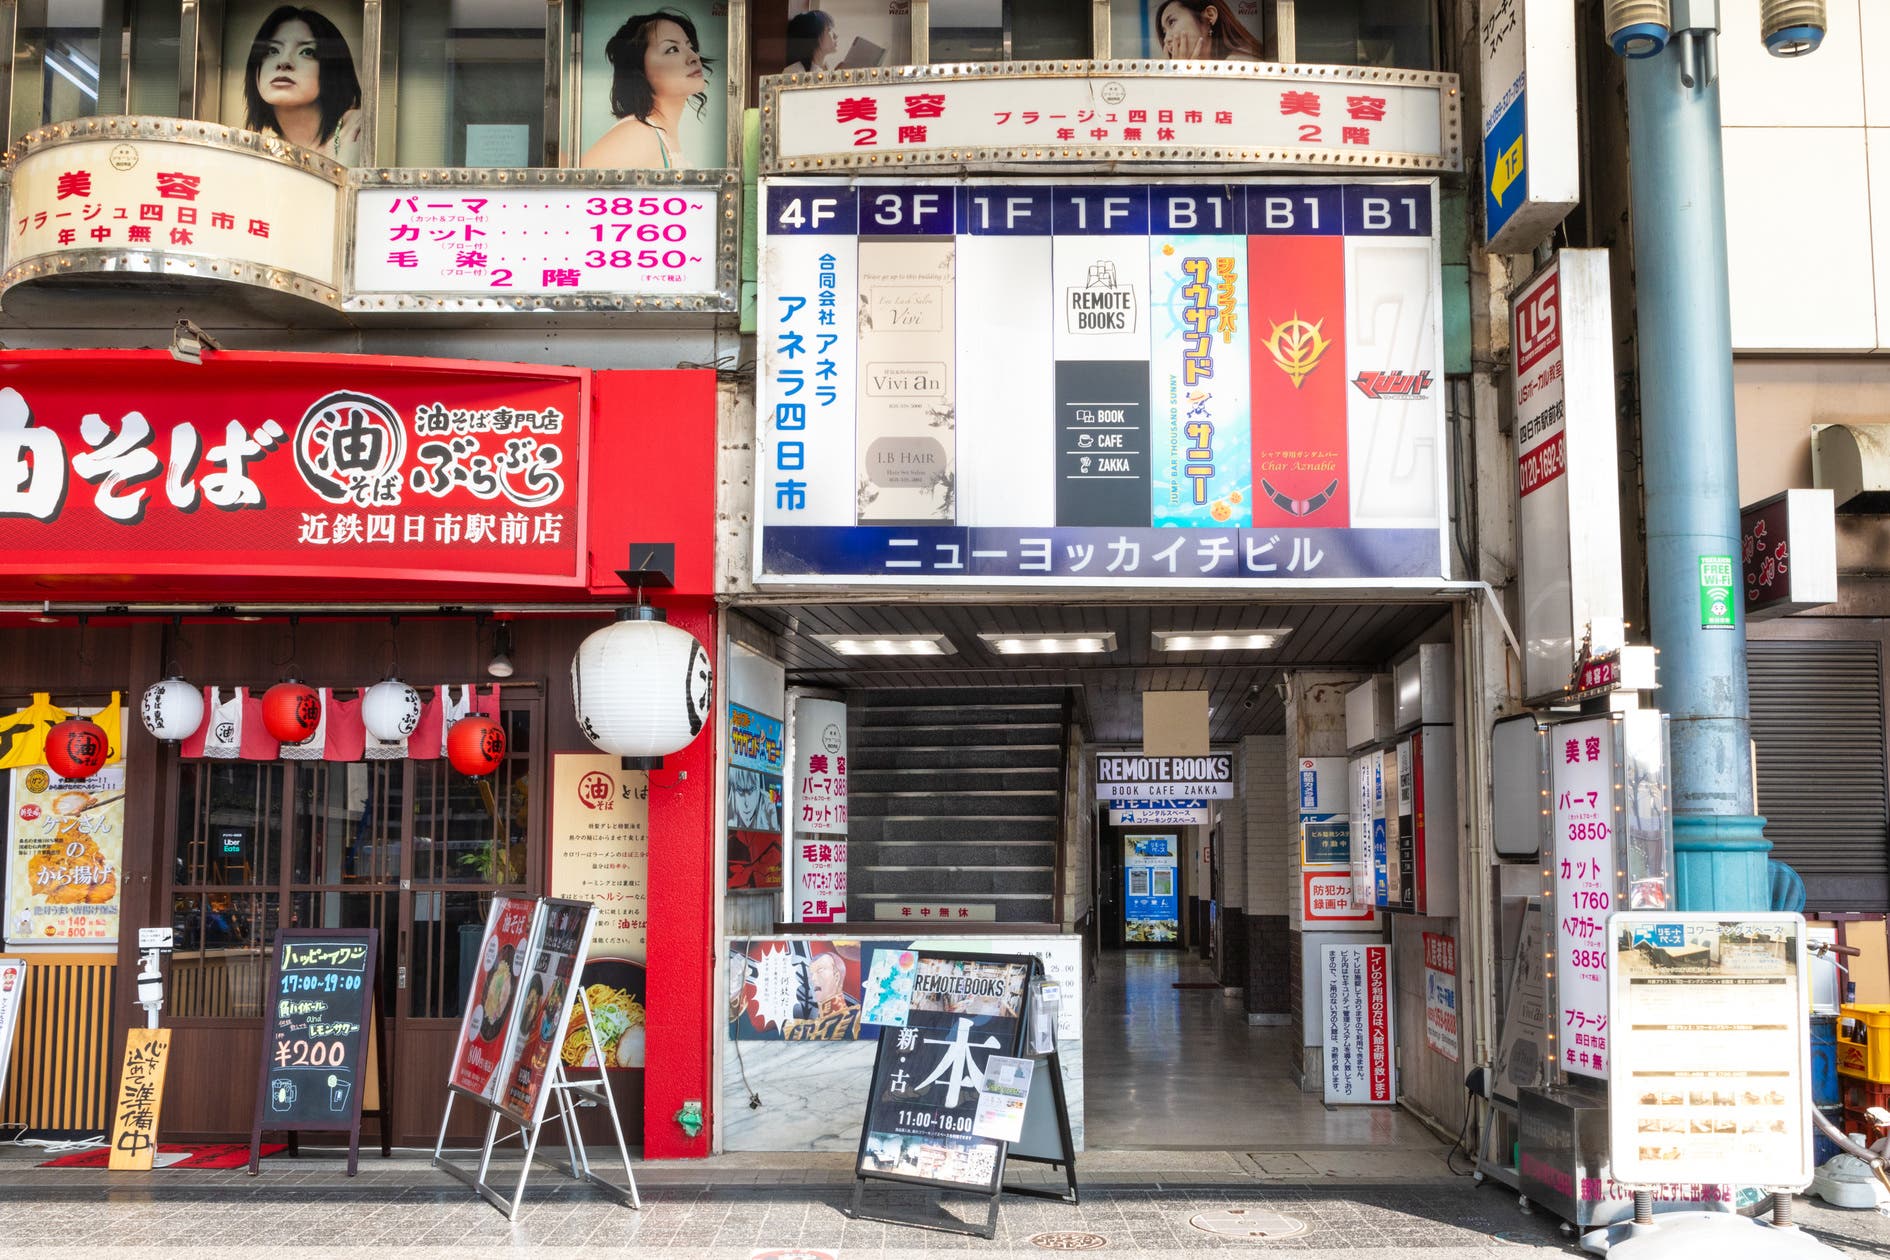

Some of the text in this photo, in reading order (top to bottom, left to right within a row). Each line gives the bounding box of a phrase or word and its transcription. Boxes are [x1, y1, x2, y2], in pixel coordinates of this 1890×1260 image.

[1489, 9, 1517, 59] スペース
[836, 94, 946, 122] 美容
[1279, 90, 1386, 122] 美容
[853, 125, 929, 146] 2階
[1056, 126, 1176, 143] 年中無休
[1299, 124, 1371, 146] 2階
[1504, 150, 1518, 179] 1F
[57, 170, 201, 201] 美容
[389, 195, 489, 215] パーマ
[780, 197, 838, 229] 4F
[875, 195, 939, 226] 3F
[974, 197, 1033, 229] 1F
[1071, 197, 1131, 229] 1F
[1168, 197, 1222, 229] B1
[1266, 197, 1321, 229] B1
[1364, 197, 1416, 229] B1
[58, 225, 194, 246] 年中無休
[389, 223, 688, 242] カット 1760
[387, 250, 488, 268] 毛染
[489, 269, 582, 287] 2階
[1072, 291, 1131, 310] REMOTE
[1216, 257, 1239, 344] ジャンプバー
[890, 308, 923, 326] Vivi
[1078, 311, 1126, 330] BOOKS
[815, 253, 838, 407] 合同会社 アネラ
[1182, 257, 1219, 505] サウザンド サニー
[1518, 359, 1562, 405] USボーカル教室
[775, 296, 808, 511] アネラ四日市
[417, 404, 562, 433] 油そば専門店
[1098, 409, 1125, 424] BOOK
[315, 408, 384, 472] 油
[1098, 435, 1123, 448] CAFE
[1170, 374, 1178, 504] JUMP BAR THOUSAND SUNNY
[901, 452, 935, 464] HAIR
[1098, 459, 1130, 472] ZAKKA
[1261, 460, 1337, 471] Char Aznable
[412, 438, 561, 503] ぶらぶら
[349, 475, 399, 502] そば
[297, 511, 564, 544] 近鉄四日市駅前店
[884, 535, 1324, 574] ニューヨッカイチビル
[1703, 565, 1731, 575] FREE
[1565, 736, 1601, 764] 美容
[809, 754, 846, 776] 美容
[1100, 757, 1230, 781] REMOTE BOOKS
[802, 777, 832, 795] パーマ
[1112, 784, 1218, 796] BOOK CAFE ZAKKA
[1559, 790, 1599, 811] パーマ
[802, 804, 832, 823] カット
[1136, 816, 1197, 824] コワーキングスペース
[1142, 809, 1191, 817] レンタルスペース
[41, 814, 113, 836] ケンさん
[66, 841, 86, 858] の
[224, 838, 240, 846] Uber
[802, 844, 832, 863] 毛染
[37, 865, 114, 886] から揚げ
[1561, 857, 1601, 881] カット
[802, 872, 833, 890] ヘアマニキュア
[802, 900, 828, 915] 2階
[1313, 899, 1347, 910] 録画中
[1572, 892, 1609, 910] 1760
[67, 916, 87, 926] 140
[901, 907, 969, 918] 年中無休
[67, 928, 87, 938] 500
[1562, 916, 1603, 939] ヘアカラー
[914, 974, 1004, 998] REMOTE BOOKS
[306, 1014, 323, 1024] and
[1370, 949, 1387, 1099] トイレのみ利用の方は、入館お断り致します
[308, 1023, 360, 1038] レモンサワー
[1575, 1033, 1606, 1050] 四日市店
[274, 1039, 346, 1068] ¥200
[914, 1018, 1001, 1108] 本
[1566, 1048, 1608, 1072] 年中無
[116, 1082, 157, 1158] 準備中
